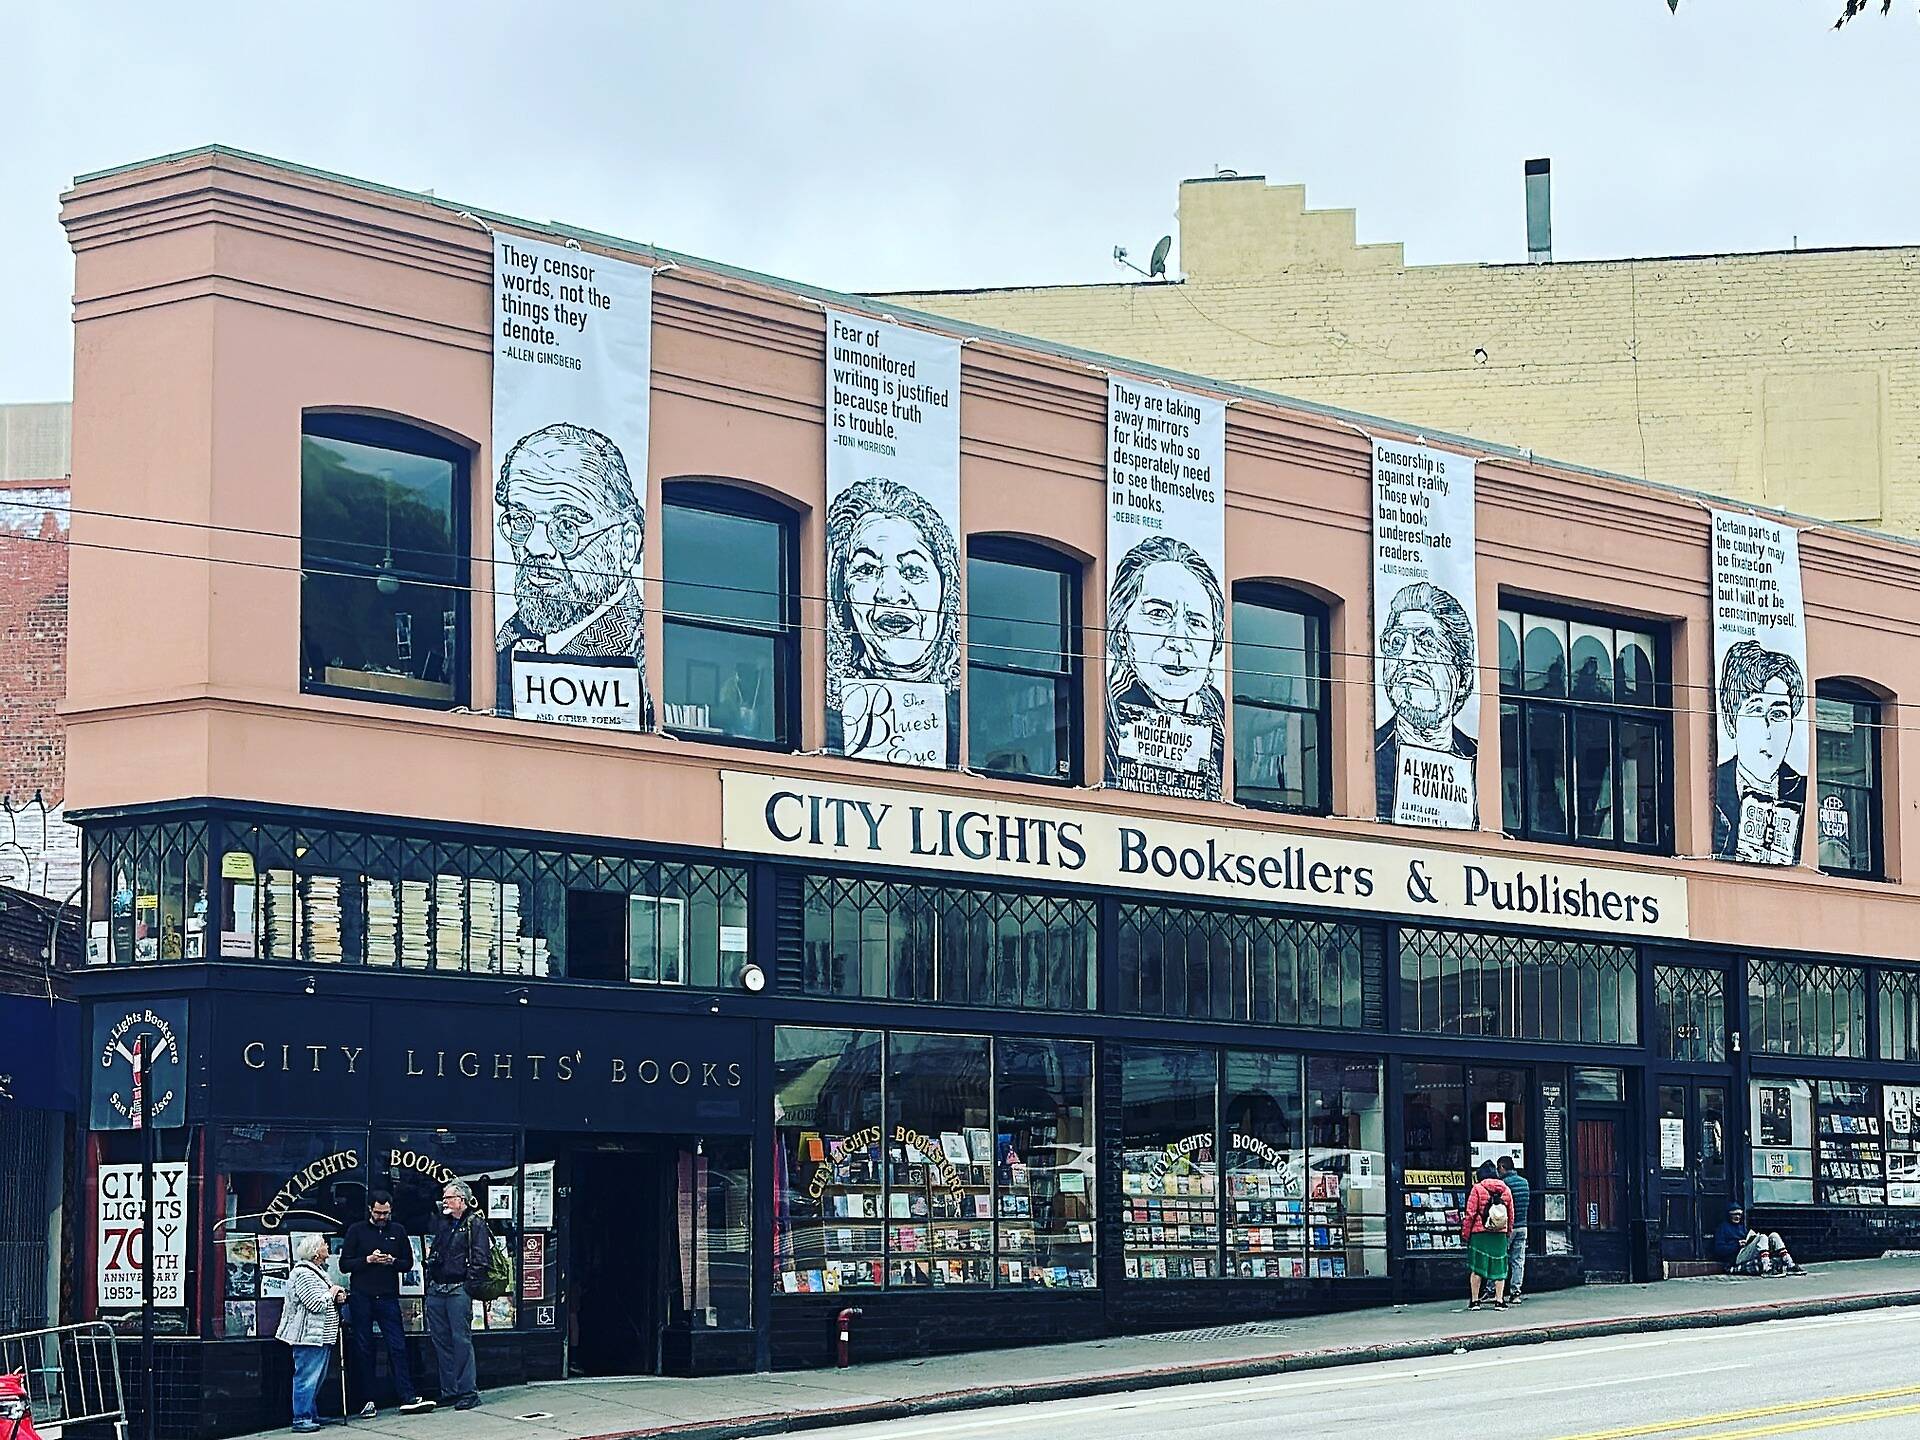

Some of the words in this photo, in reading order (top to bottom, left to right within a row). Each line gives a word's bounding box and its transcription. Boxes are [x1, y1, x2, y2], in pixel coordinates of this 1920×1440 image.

[501, 244, 538, 275] They
[543, 258, 595, 282] censor
[502, 273, 554, 300] words,
[560, 286, 584, 303] not
[588, 288, 611, 310] the
[501, 293, 549, 325] things
[554, 304, 588, 333] they
[502, 317, 560, 346] denote.
[834, 320, 863, 345] Fear
[866, 330, 880, 348] of
[537, 352, 582, 371] GINSBERG
[834, 347, 916, 379] unmonitored
[833, 368, 879, 396] writing
[883, 376, 894, 395] is
[896, 379, 949, 408] justified
[834, 386, 888, 415] because
[892, 401, 922, 424] truth
[1114, 384, 1142, 411] They
[1144, 396, 1163, 411] are
[1166, 398, 1201, 425] taking
[833, 408, 845, 428] is
[849, 413, 898, 440] trouble.
[1114, 410, 1143, 432] away
[1147, 415, 1189, 438] mirrors
[857, 440, 896, 457] MORRISON
[1114, 426, 1130, 444] for
[1133, 430, 1157, 451] kids
[1161, 438, 1184, 457] who
[1187, 447, 1200, 461] so
[1113, 446, 1180, 481] desperately
[1183, 466, 1211, 483] need
[1378, 446, 1434, 475] Censorship
[1436, 459, 1445, 474] is
[1113, 467, 1124, 484] to
[1128, 473, 1148, 489] see
[1150, 474, 1215, 504] themselves
[1378, 469, 1415, 487] against
[1418, 475, 1450, 497] reality.
[1378, 484, 1407, 504] Those
[1410, 490, 1430, 509] who
[1112, 487, 1124, 505] in
[1128, 489, 1165, 514] books.
[1379, 503, 1398, 521] ban
[1400, 508, 1428, 527] books
[1717, 517, 1746, 536] Certain
[1749, 526, 1770, 541] parts
[1772, 530, 1780, 543] of
[1380, 544, 1423, 563] readers.
[1717, 535, 1731, 550] the
[1768, 547, 1785, 564] may
[1717, 551, 1729, 566] be
[1759, 562, 1772, 574] on
[1718, 586, 1734, 601] but
[1735, 588, 1739, 602] I
[1773, 593, 1784, 608] be
[1760, 612, 1796, 629] myself.
[526, 675, 629, 708] HOWL
[903, 693, 925, 708] The
[557, 714, 587, 724] OTHER
[592, 716, 622, 725] POEMS
[841, 683, 939, 758] Bluest
[1157, 715, 1171, 729] AN
[1134, 725, 1193, 748] INDIGENOUS
[1138, 742, 1188, 761] PEOPLES'
[1121, 762, 1159, 782] HISTORY
[1165, 770, 1178, 786] OF
[1185, 774, 1204, 790] THE
[1404, 758, 1455, 783] ALWAYS
[1121, 777, 1158, 795] UNITED
[1161, 784, 1201, 800] STATES
[1413, 777, 1468, 804] RUNNING
[765, 791, 892, 851] CITY
[909, 806, 1087, 871] LIGHTS
[1118, 827, 1374, 897] Booksellers
[1406, 859, 1439, 904] &
[1463, 865, 1659, 924] Publishers
[101, 1038, 117, 1068] City
[111, 1012, 141, 1039] Lights
[145, 1009, 179, 1064] Bookstore
[243, 1041, 364, 1073] CITY
[610, 1058, 742, 1087] BOOKS
[110, 1092, 126, 1116] San
[128, 1090, 173, 1119] Fcisco
[809, 1159, 833, 1199] CITY
[831, 1126, 880, 1164] LIGHTS
[896, 1126, 965, 1201] BOOKSTORE
[1147, 1154, 1172, 1192] CITY
[1167, 1133, 1213, 1161] LIGHTS
[1233, 1133, 1298, 1194] BOOKSTORE
[261, 1181, 298, 1229] CITY
[293, 1150, 358, 1192] LIGHTS
[1417, 1175, 1452, 1184] LIGHTS
[103, 1201, 182, 1220] LIGTS
[104, 1286, 178, 1300] 1953-023
